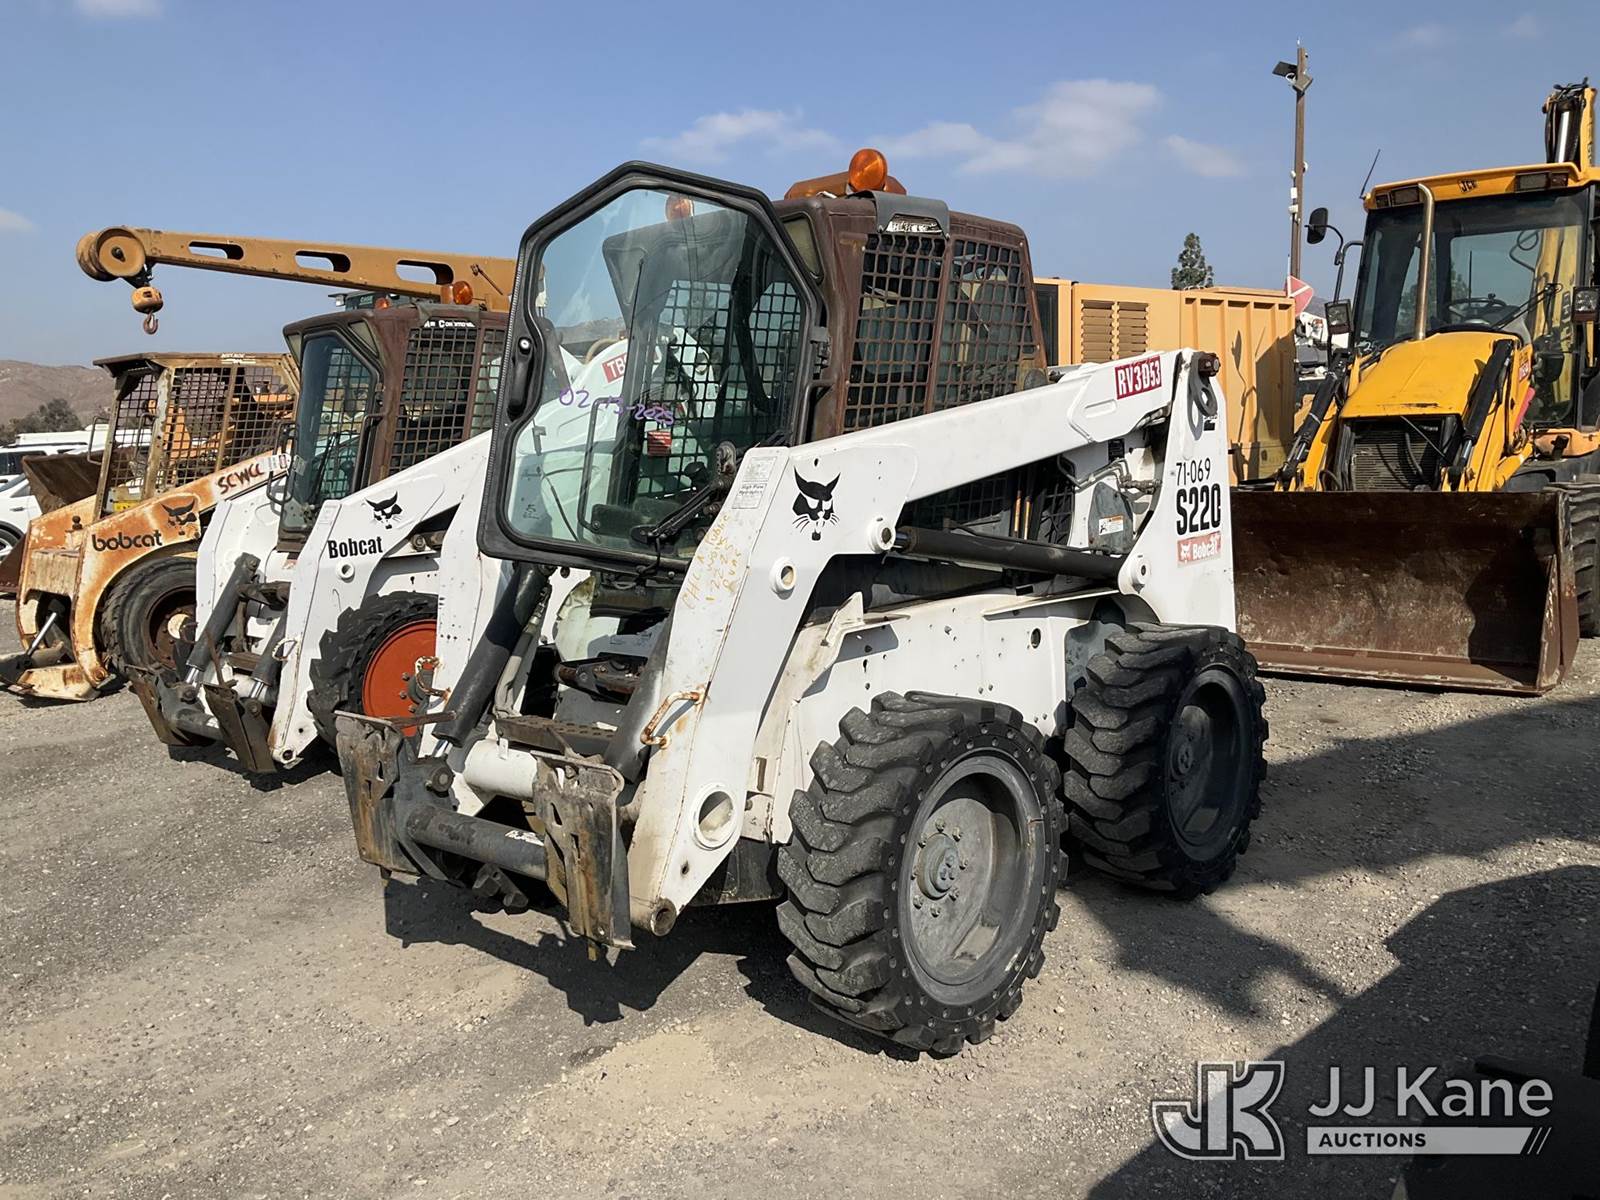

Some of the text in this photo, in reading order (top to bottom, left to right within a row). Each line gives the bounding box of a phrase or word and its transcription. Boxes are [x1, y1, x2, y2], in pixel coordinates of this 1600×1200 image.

[1176, 457, 1211, 486] 71-069
[1176, 483, 1221, 536] S220
[92, 530, 163, 551] bobcat
[327, 536, 383, 559] Bobcat
